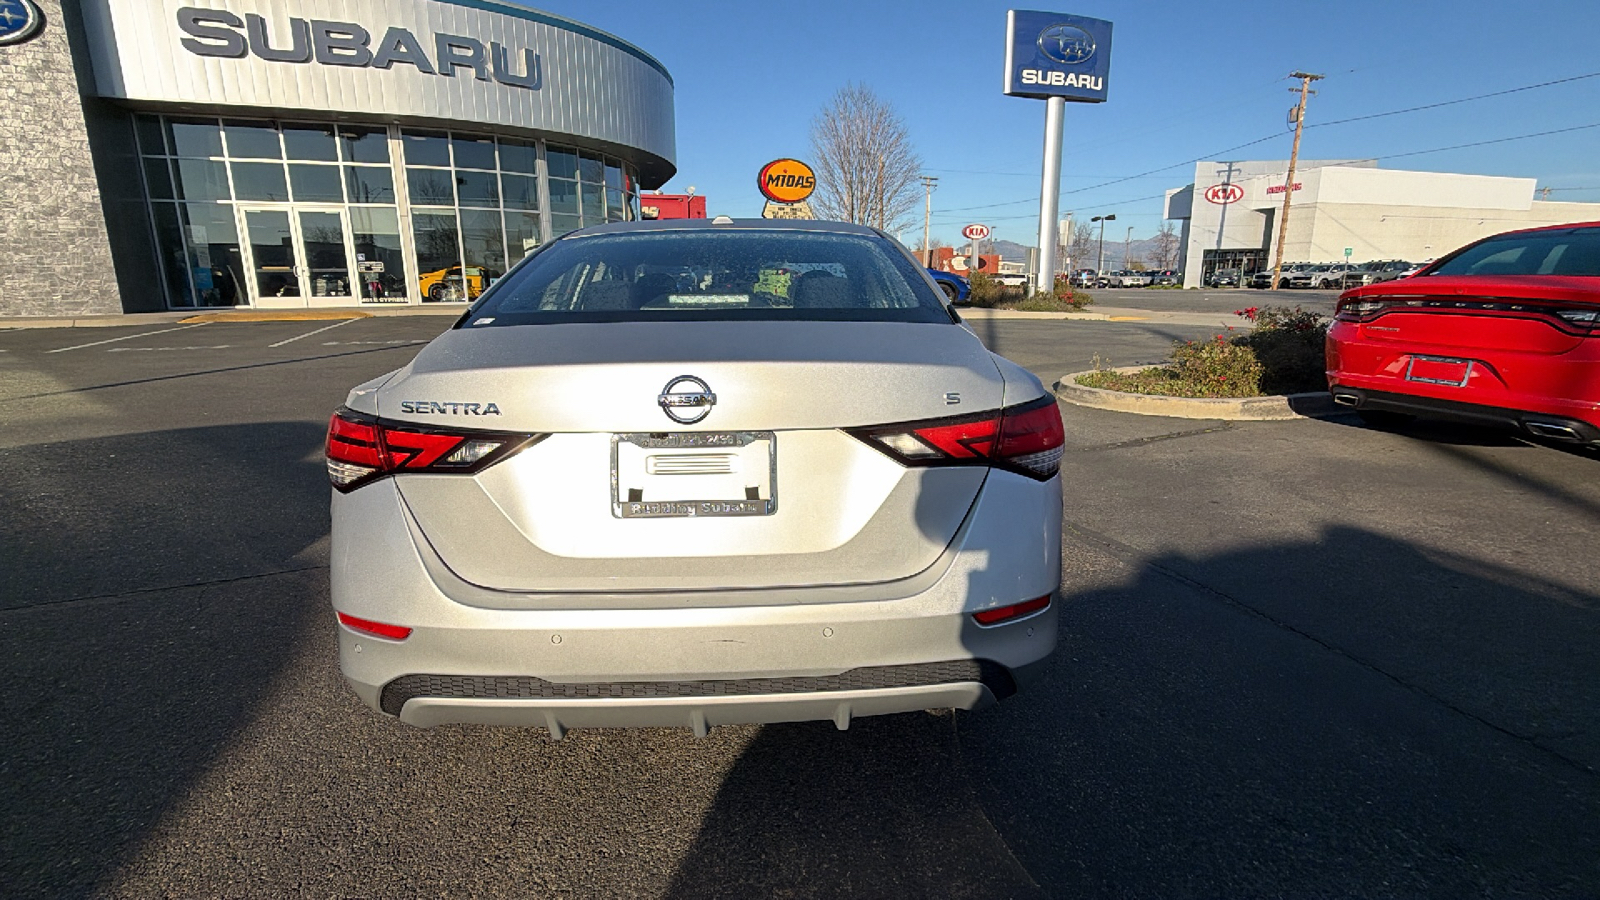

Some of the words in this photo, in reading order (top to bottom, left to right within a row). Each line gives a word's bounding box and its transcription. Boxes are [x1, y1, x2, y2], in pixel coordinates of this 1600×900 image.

[177, 7, 542, 91] SUBARU
[1021, 69, 1103, 91] SUBARU
[766, 169, 814, 188] MIDAS
[1211, 188, 1238, 200] KIA
[968, 227, 986, 236] KIA
[946, 392, 960, 405] S
[401, 400, 502, 415] SENTRA
